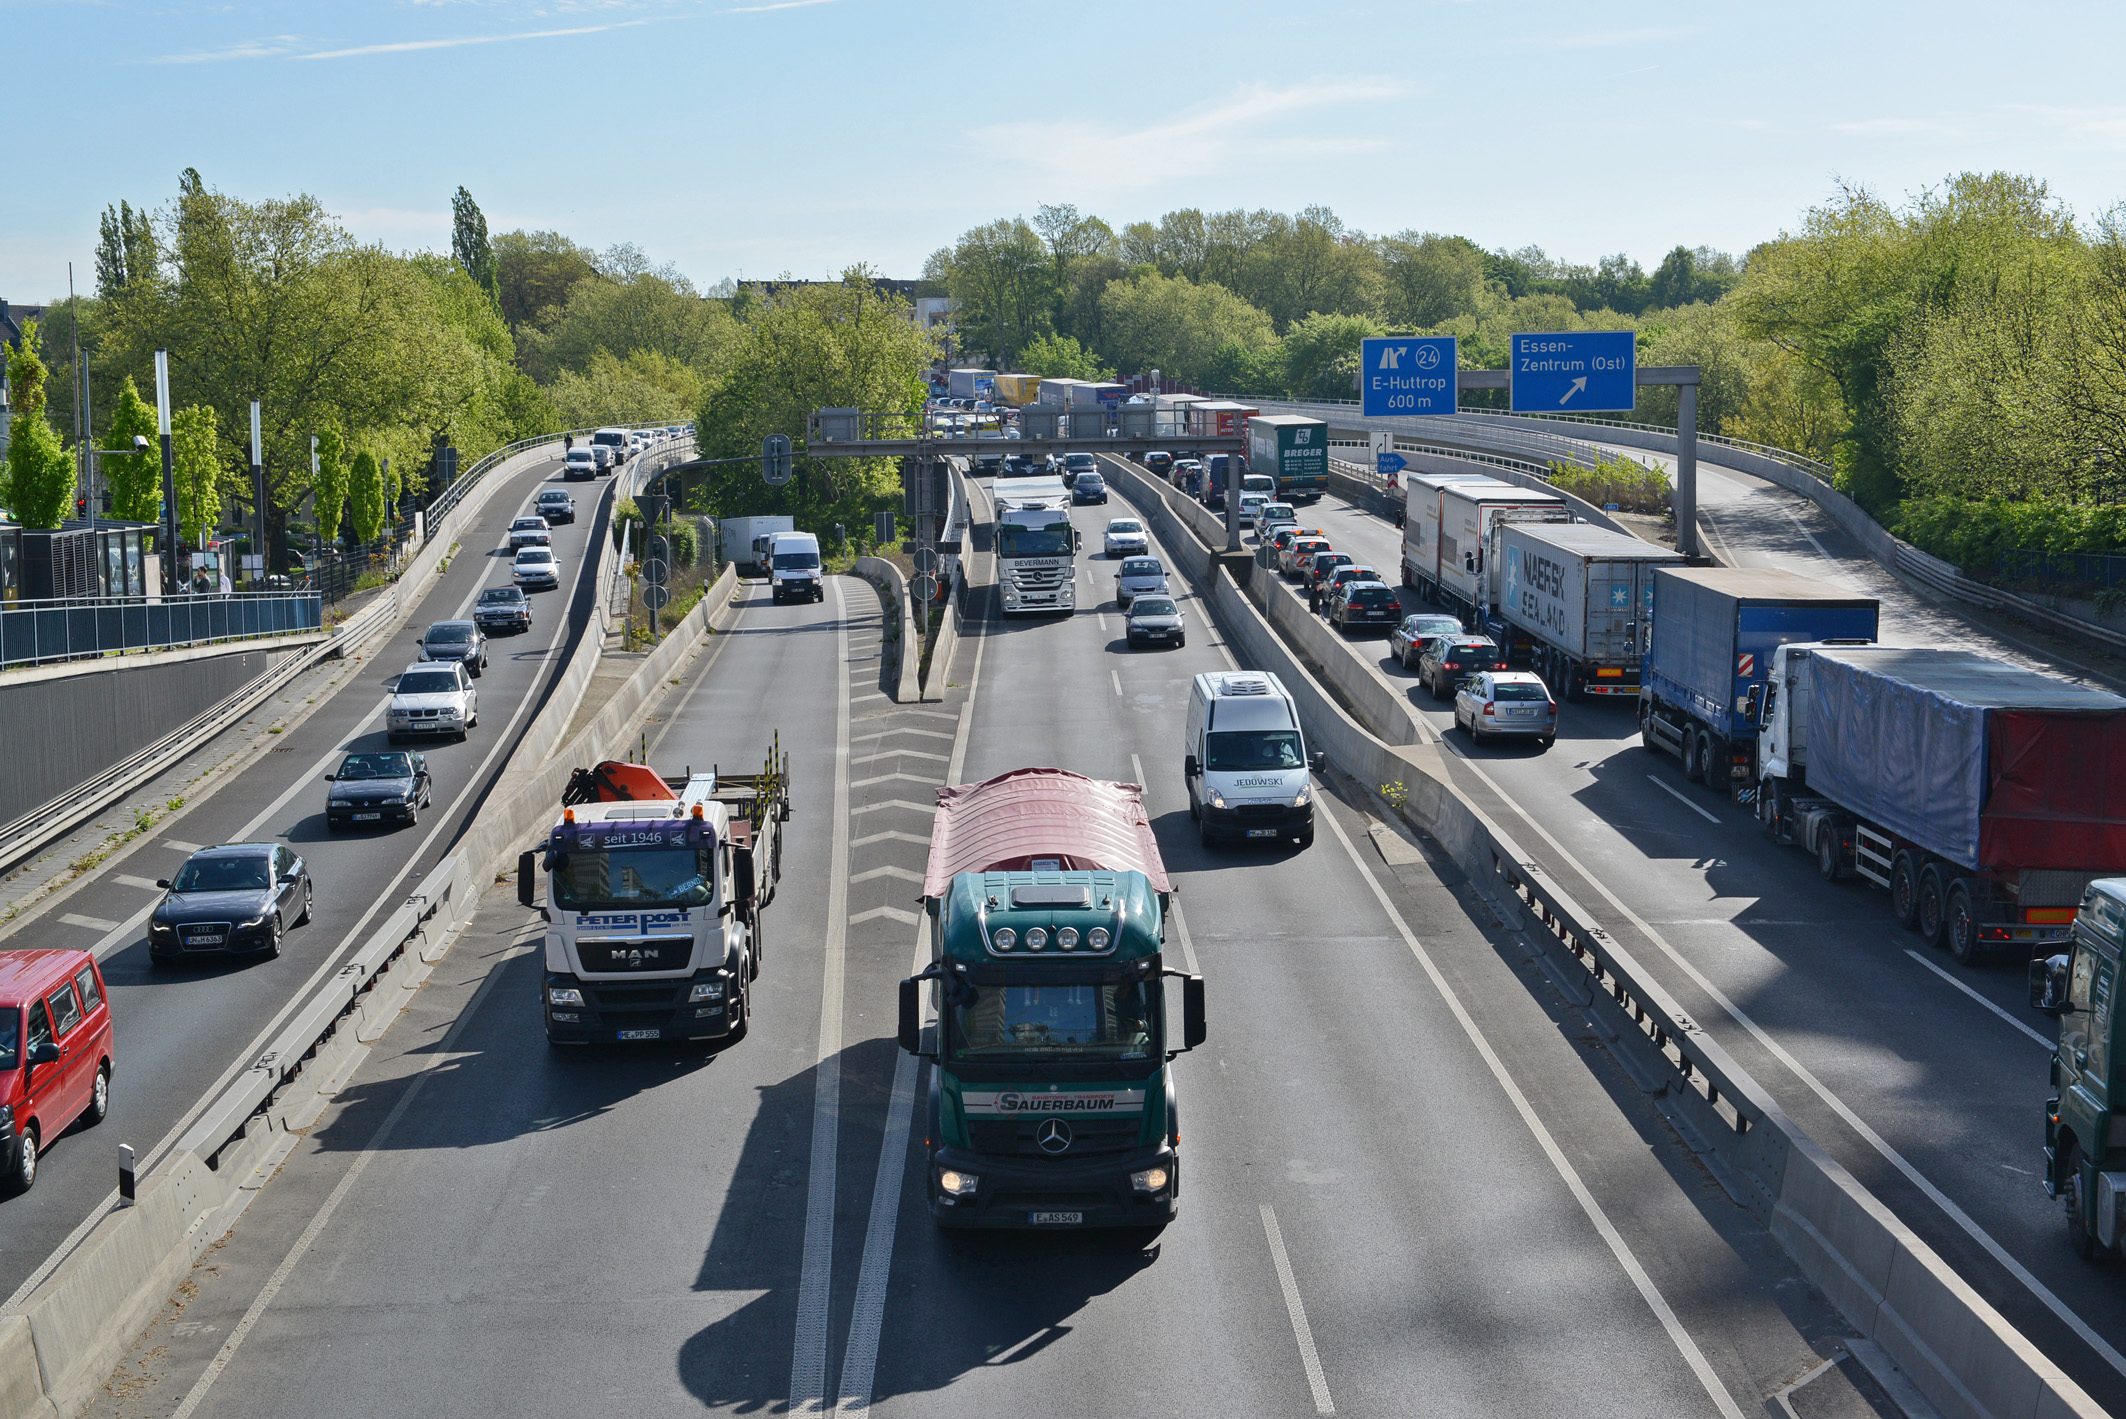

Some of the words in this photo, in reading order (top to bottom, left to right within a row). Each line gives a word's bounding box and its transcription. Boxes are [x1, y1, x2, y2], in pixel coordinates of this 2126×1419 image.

[1520, 339, 1574, 353] Essen-
[1419, 350, 1437, 364] 24
[1520, 358, 1585, 372] Zentrum
[1591, 355, 1626, 371] (Ost)
[1372, 376, 1446, 392] E-Huttrop
[1388, 394, 1415, 408] 600
[1418, 397, 1431, 408] m
[1283, 448, 1323, 458] BREGER
[1380, 455, 1398, 463] Aus-
[1014, 559, 1060, 567] BEVERMANN
[1233, 777, 1284, 787] JEDOWSKI
[604, 832, 627, 844] seit
[631, 832, 662, 843] 1946
[678, 877, 701, 893] BERND
[576, 914, 638, 925] PETER
[611, 949, 659, 959] MAN
[1007, 1099, 1114, 1110] SAUERBAUM
[1061, 1213, 1079, 1221] 549
